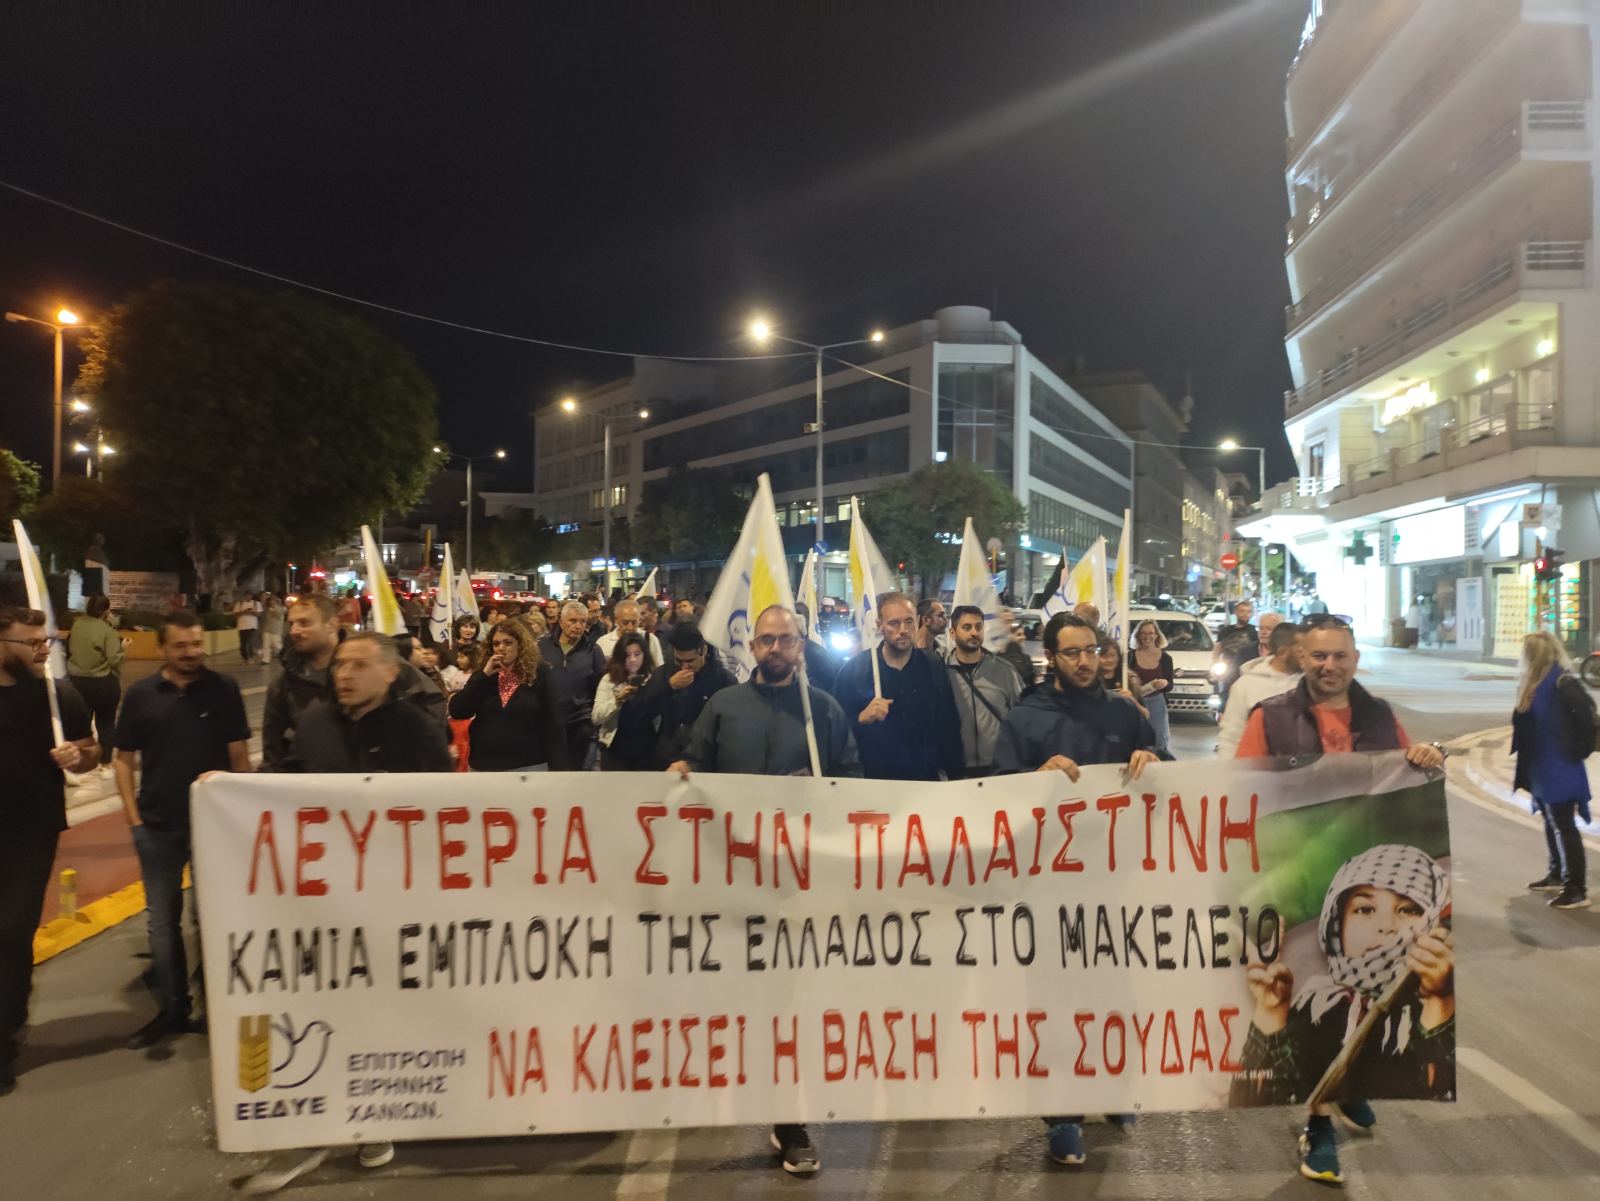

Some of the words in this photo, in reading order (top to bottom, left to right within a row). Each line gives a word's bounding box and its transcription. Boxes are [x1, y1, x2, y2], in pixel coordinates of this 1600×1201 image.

[247, 804, 598, 897] ΛΕΥΤΕΡΙΑ
[634, 801, 812, 892] ΣΤΗΝ
[847, 793, 1261, 891] ΠΑΛΑΙΣΤΙΝΗ
[228, 926, 372, 995] ΚΑΜΙΑ
[399, 915, 613, 991] ΕΜΠΛΟΚΗ
[637, 912, 722, 976] ΤΗΣ
[745, 910, 933, 972] ΕΛΛΑΔΟΣ
[954, 904, 1037, 967] ΣΤΟ
[1058, 902, 1281, 971] ΜΑΚΕΛΕΙΟ
[347, 1048, 467, 1072] ΕΠΙΤΡΟΠΗ
[488, 1025, 549, 1101] ΝΑ
[570, 1013, 748, 1093] ΚΛΕΙΣΕΙ
[772, 1014, 801, 1085] Η
[821, 1008, 941, 1083] ΒΑΣΗ
[960, 1010, 1050, 1080] ΤΗΣ
[1073, 1006, 1245, 1078] ΣΟΥΔΑΣ
[235, 1096, 328, 1121] ΕΕΔΥΕ
[347, 1075, 449, 1097] ΕΙΡΗΝΗΣ
